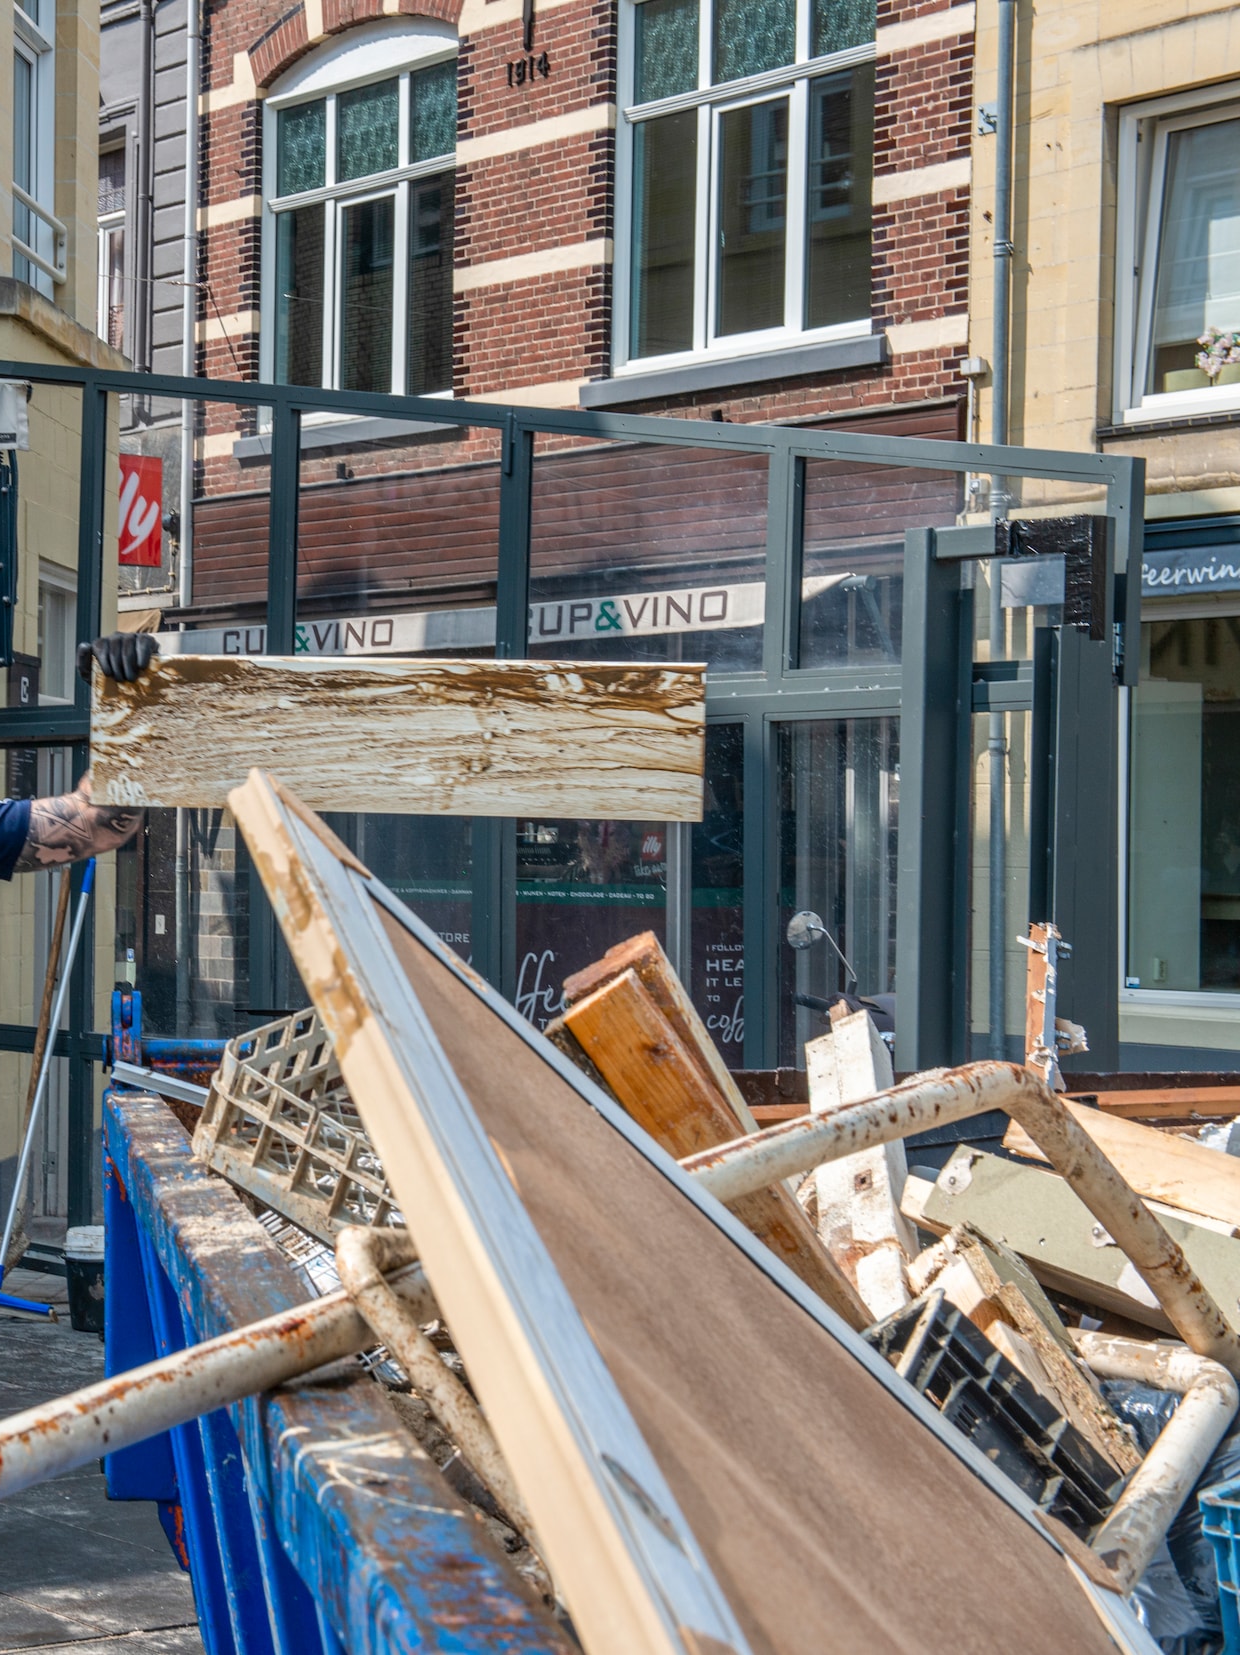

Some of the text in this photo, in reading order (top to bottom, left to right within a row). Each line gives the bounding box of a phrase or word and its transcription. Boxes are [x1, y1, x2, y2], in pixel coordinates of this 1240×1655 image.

[507, 51, 551, 88] 1914
[528, 590, 728, 636] UP&VINO
[642, 835, 662, 857] illy
[706, 959, 744, 972] HEA
[706, 978, 742, 988] IT LE
[707, 995, 721, 1003] TO
